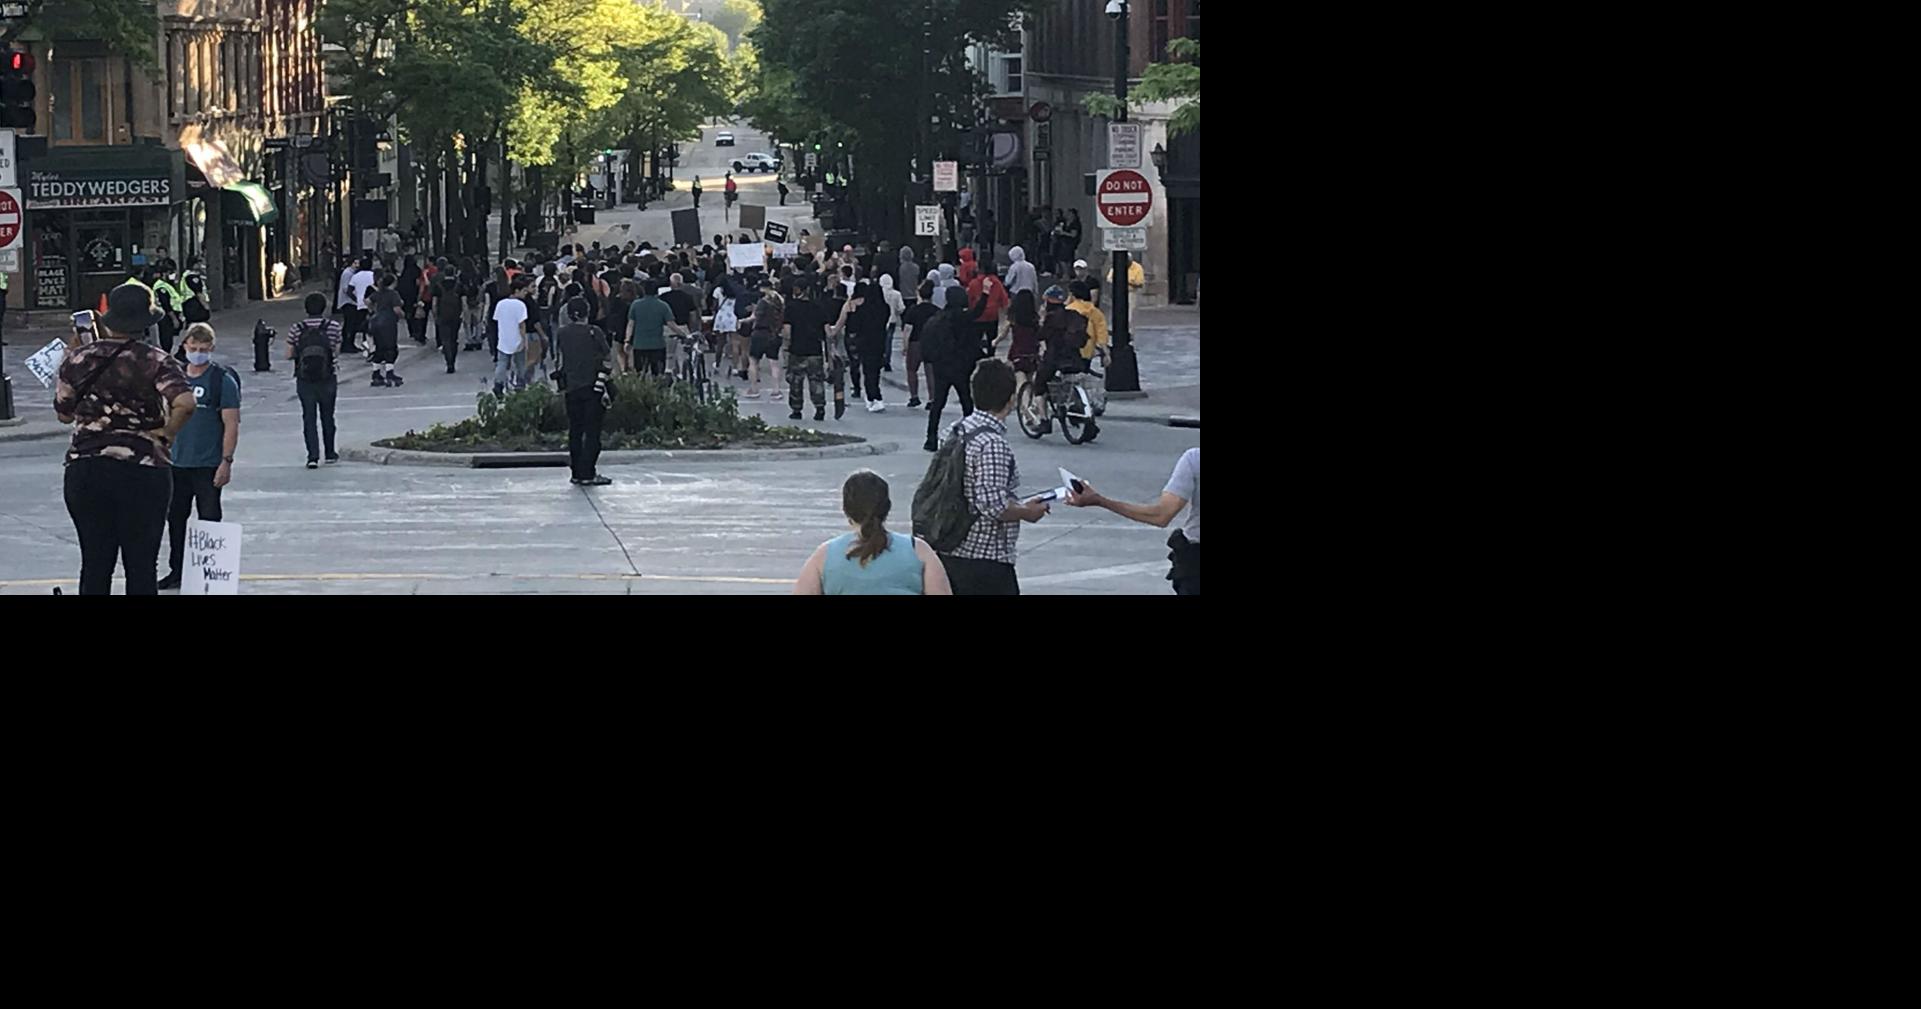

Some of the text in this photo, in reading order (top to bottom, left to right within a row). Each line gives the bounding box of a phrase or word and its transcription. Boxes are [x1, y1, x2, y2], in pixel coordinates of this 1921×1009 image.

[31, 180, 170, 197] TEDDYWEDGERS
[1106, 181, 1143, 190] DO NOT
[0, 201, 12, 210] OT
[1107, 206, 1143, 216] ENTER
[921, 222, 935, 233] 15
[189, 527, 227, 551] #Black
[191, 551, 216, 567] Lives
[203, 567, 233, 581] Matter
